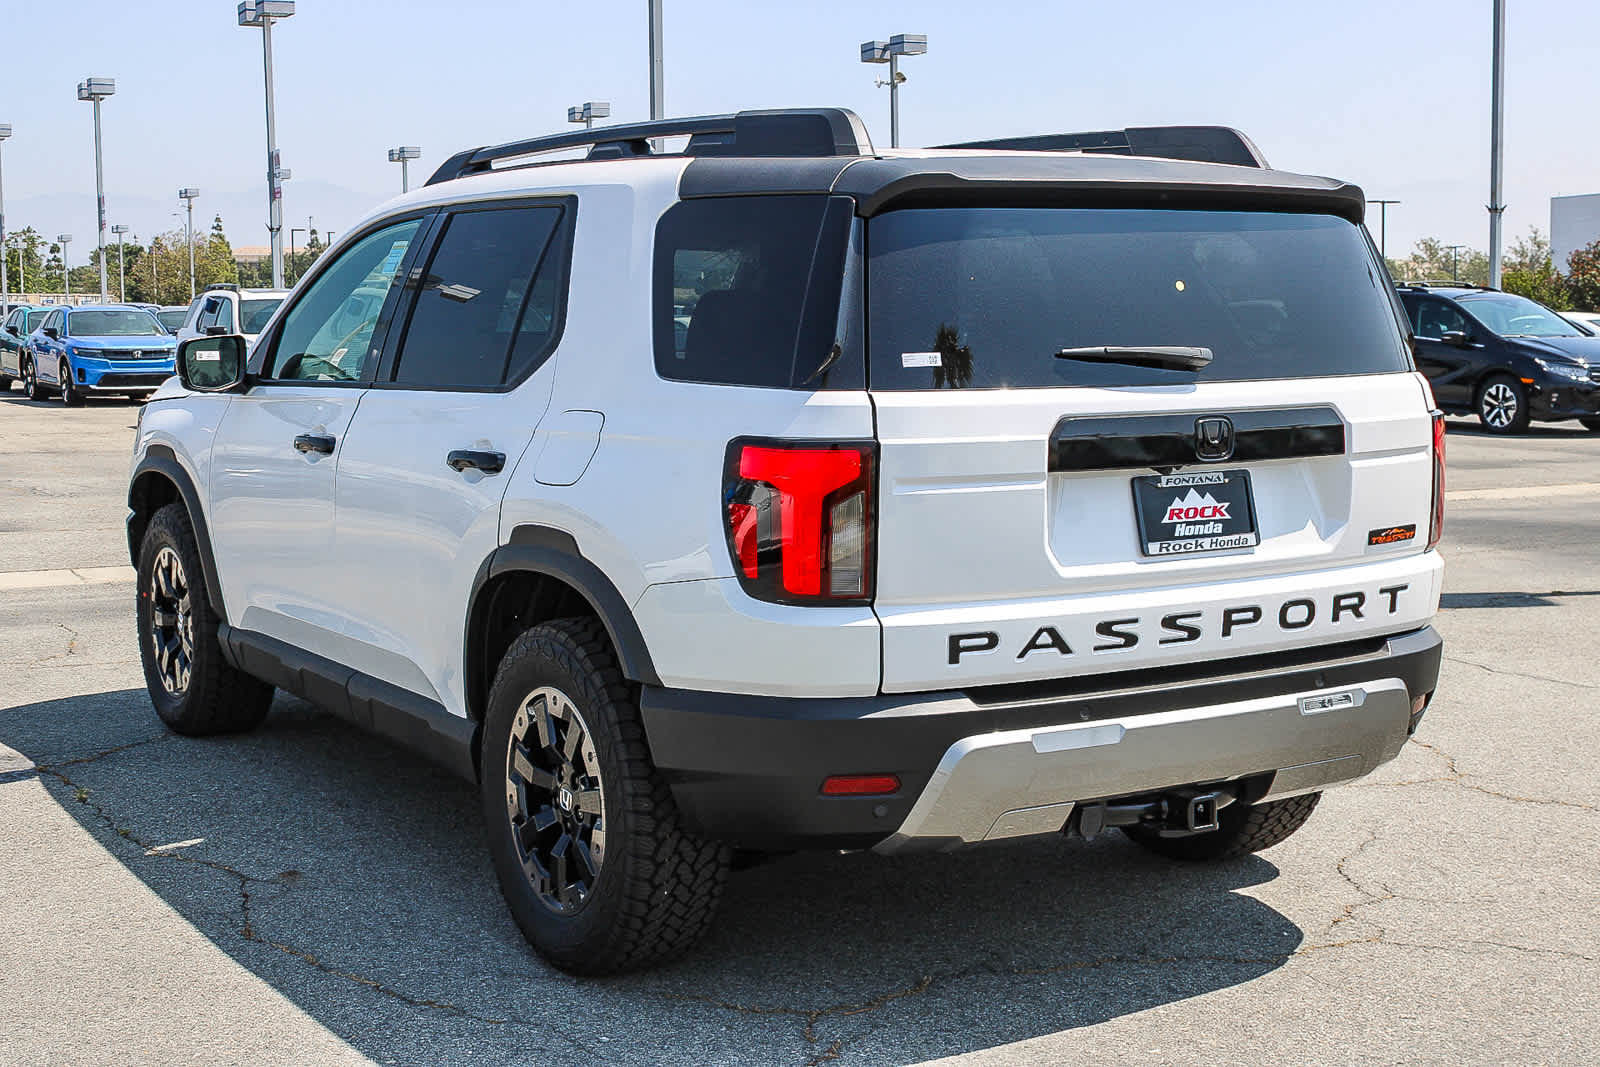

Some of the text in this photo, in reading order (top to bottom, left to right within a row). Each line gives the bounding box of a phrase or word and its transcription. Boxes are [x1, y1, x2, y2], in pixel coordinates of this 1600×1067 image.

[1165, 473, 1222, 486] FONTANA
[1168, 504, 1227, 521] ROCK
[1174, 521, 1223, 537] Honda
[1158, 536, 1249, 553] Rock Honda
[948, 584, 1408, 665] PASSPORT
